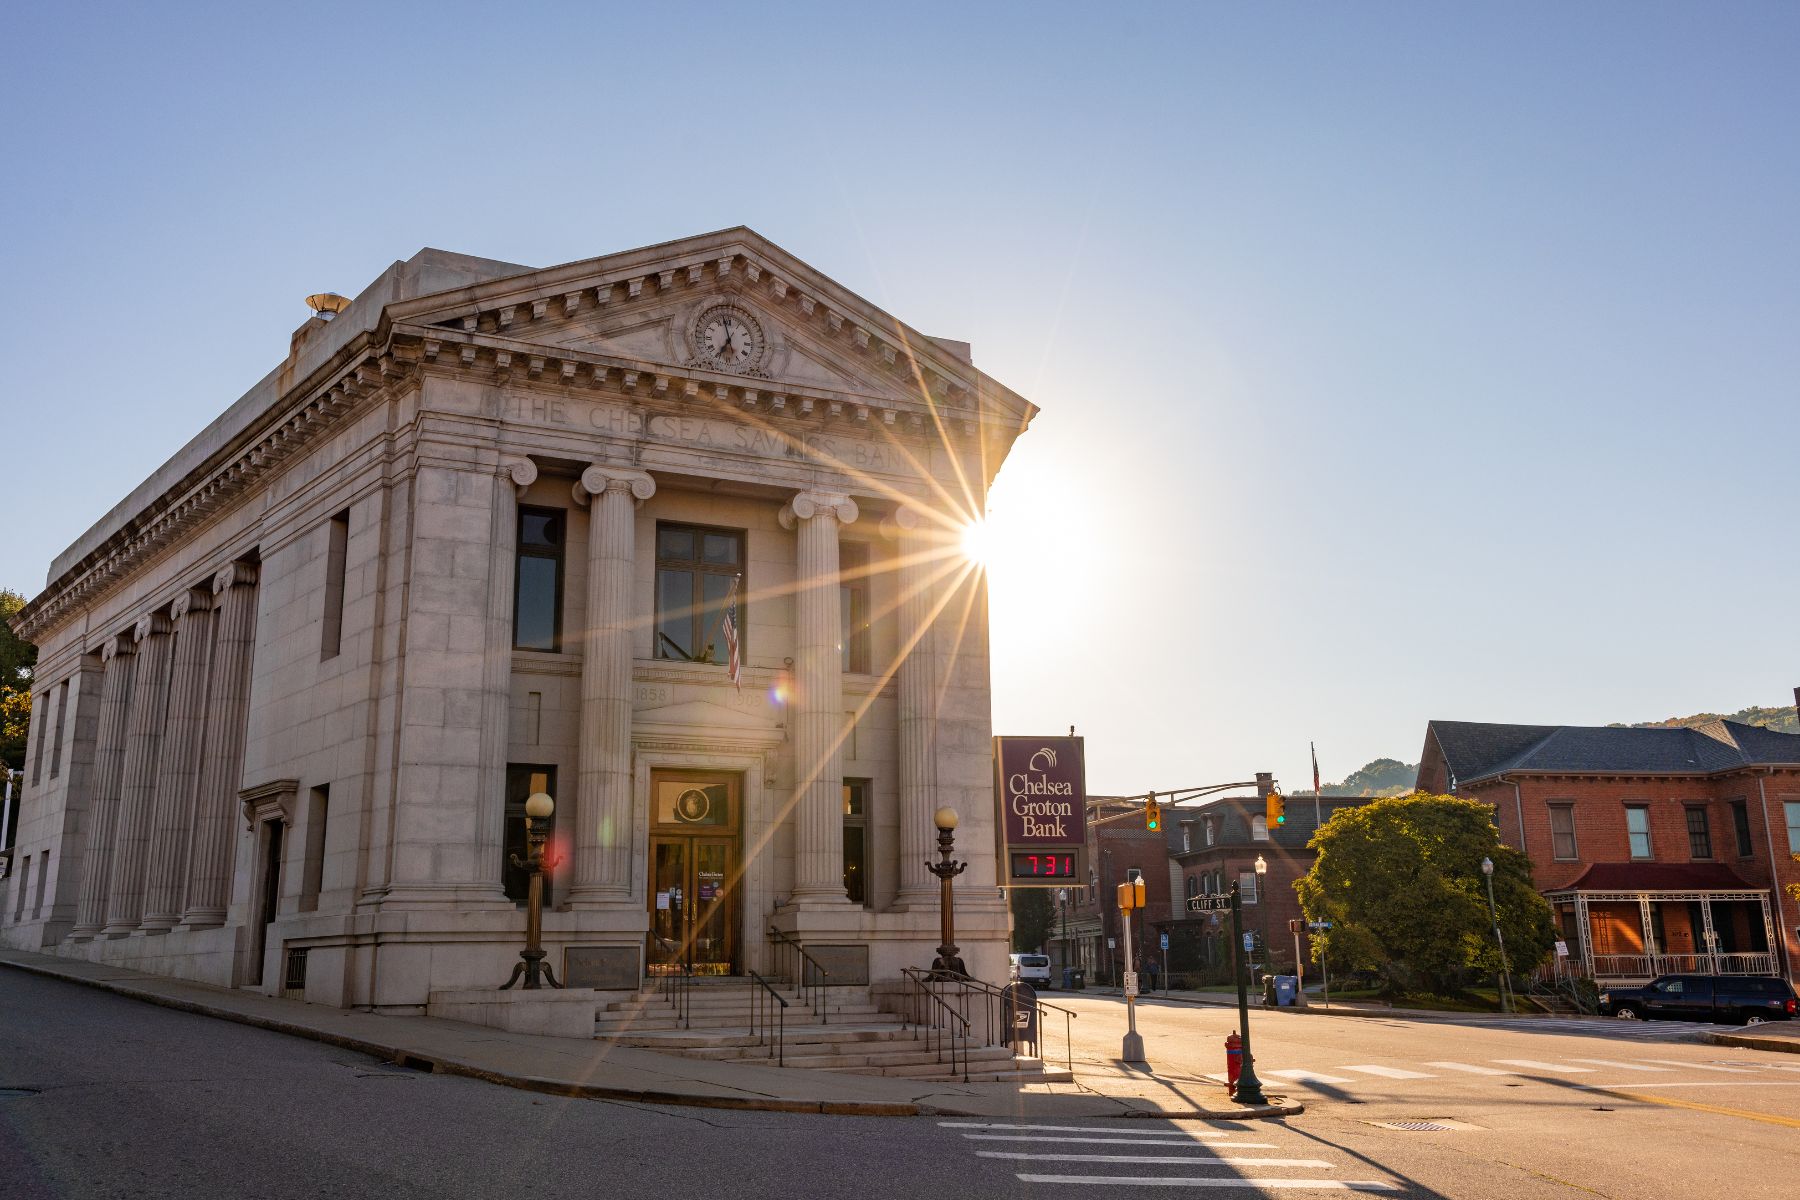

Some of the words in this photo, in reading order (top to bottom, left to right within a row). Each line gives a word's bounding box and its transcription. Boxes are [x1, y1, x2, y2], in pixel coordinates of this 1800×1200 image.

[512, 396, 567, 425] THE
[855, 443, 916, 472] BAN
[1009, 773, 1073, 796] Chelsea
[1012, 795, 1072, 816] Groton
[1021, 816, 1067, 837] Bank
[1191, 899, 1212, 910] CLIFF
[1216, 898, 1227, 909] ST.
